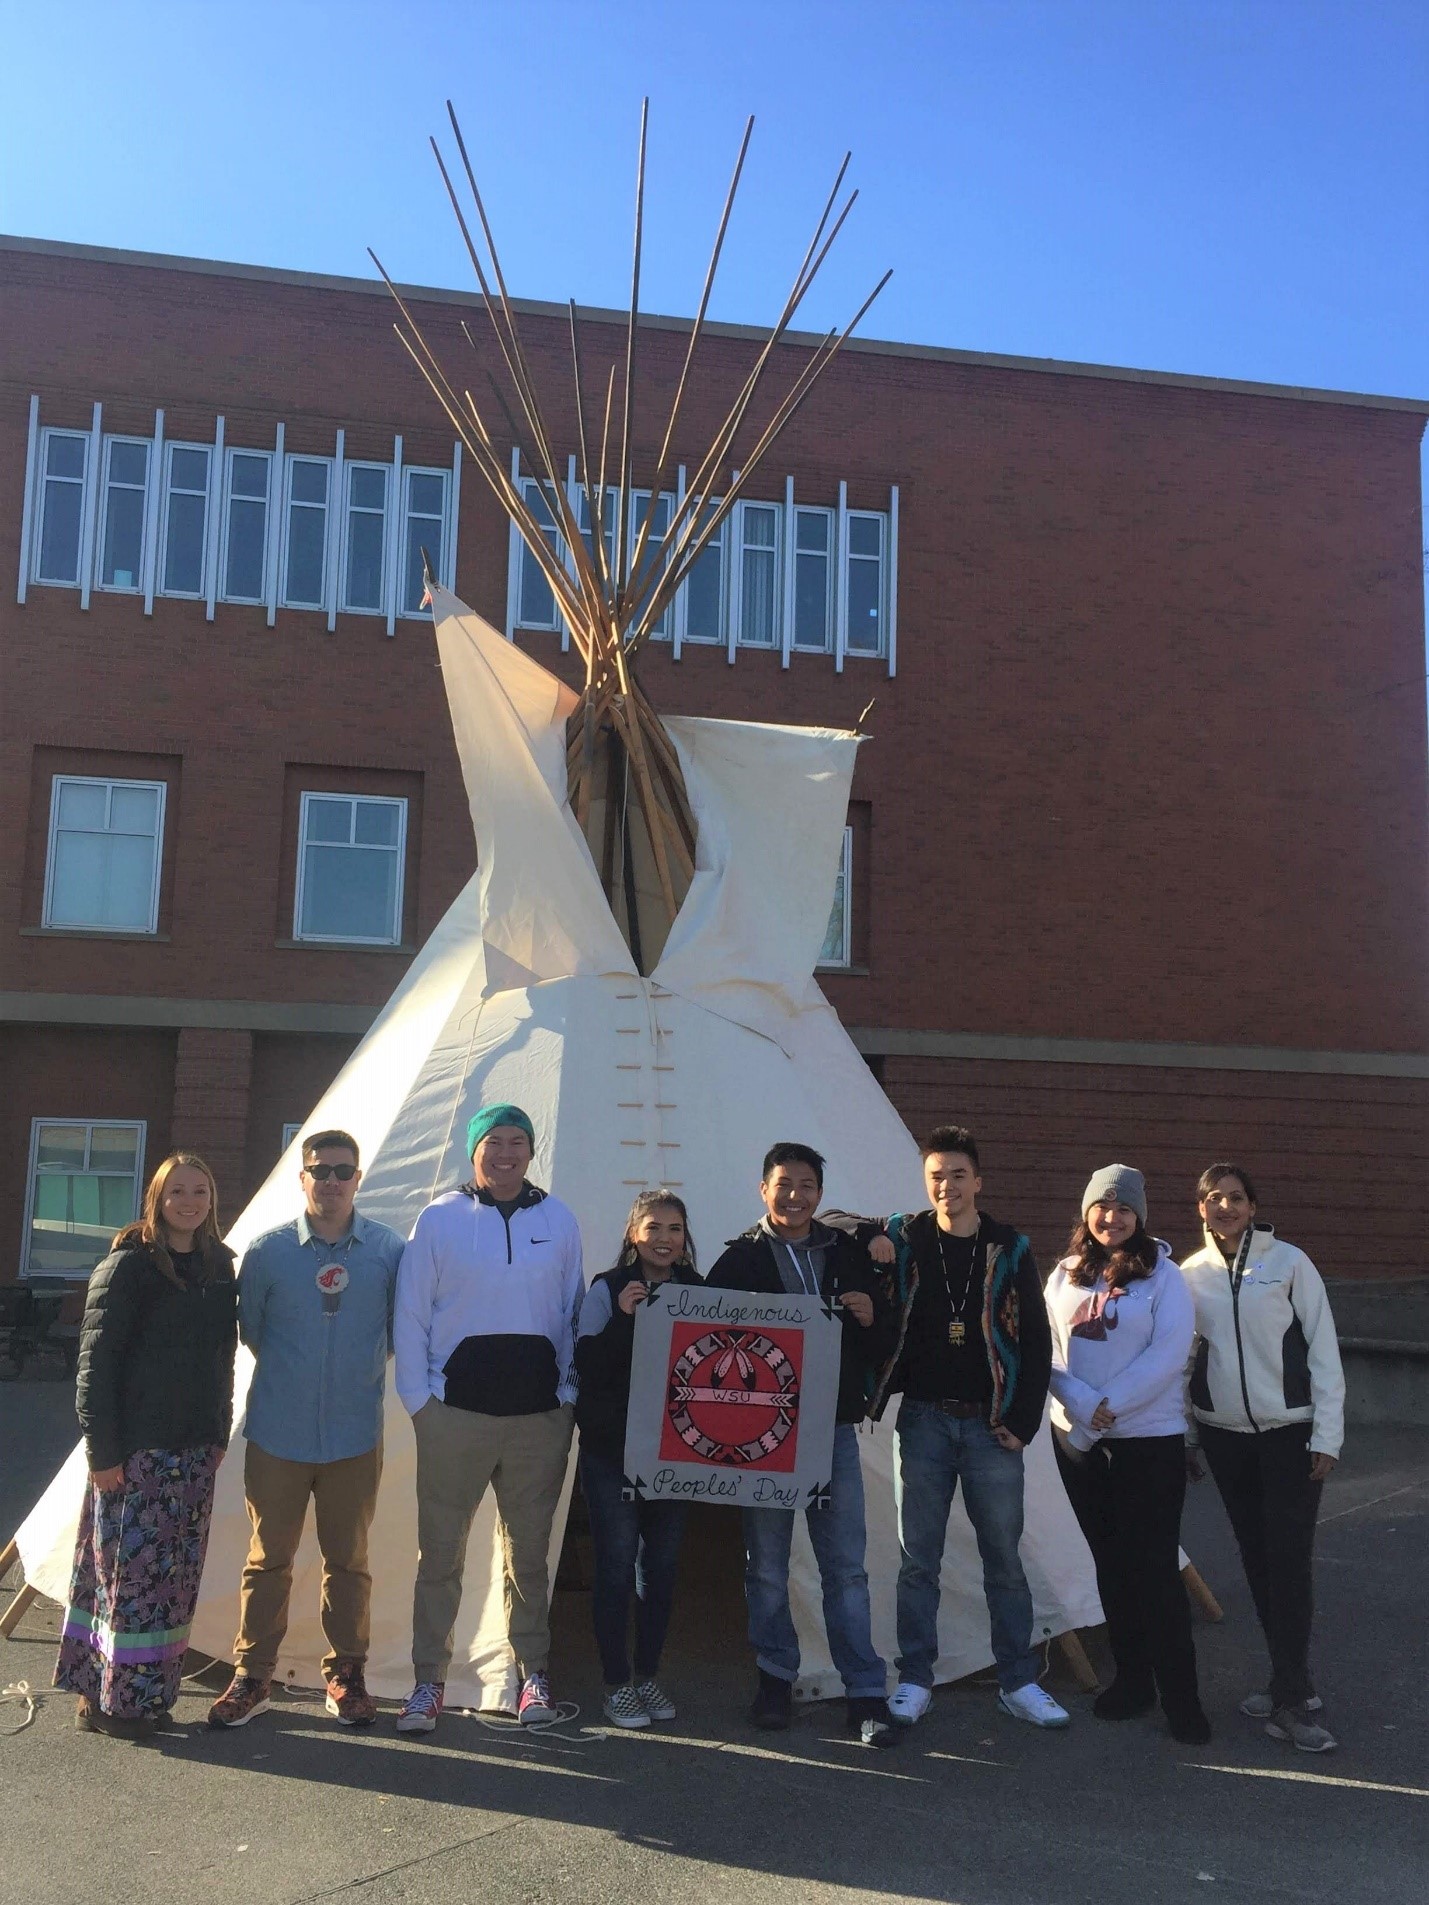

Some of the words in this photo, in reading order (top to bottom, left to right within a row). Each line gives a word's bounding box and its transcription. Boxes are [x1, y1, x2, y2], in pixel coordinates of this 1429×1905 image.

[667, 1289, 811, 1324] Indigenous
[713, 1389, 751, 1402] WSU
[653, 1469, 742, 1496] Peoples'
[753, 1478, 799, 1507] Day
